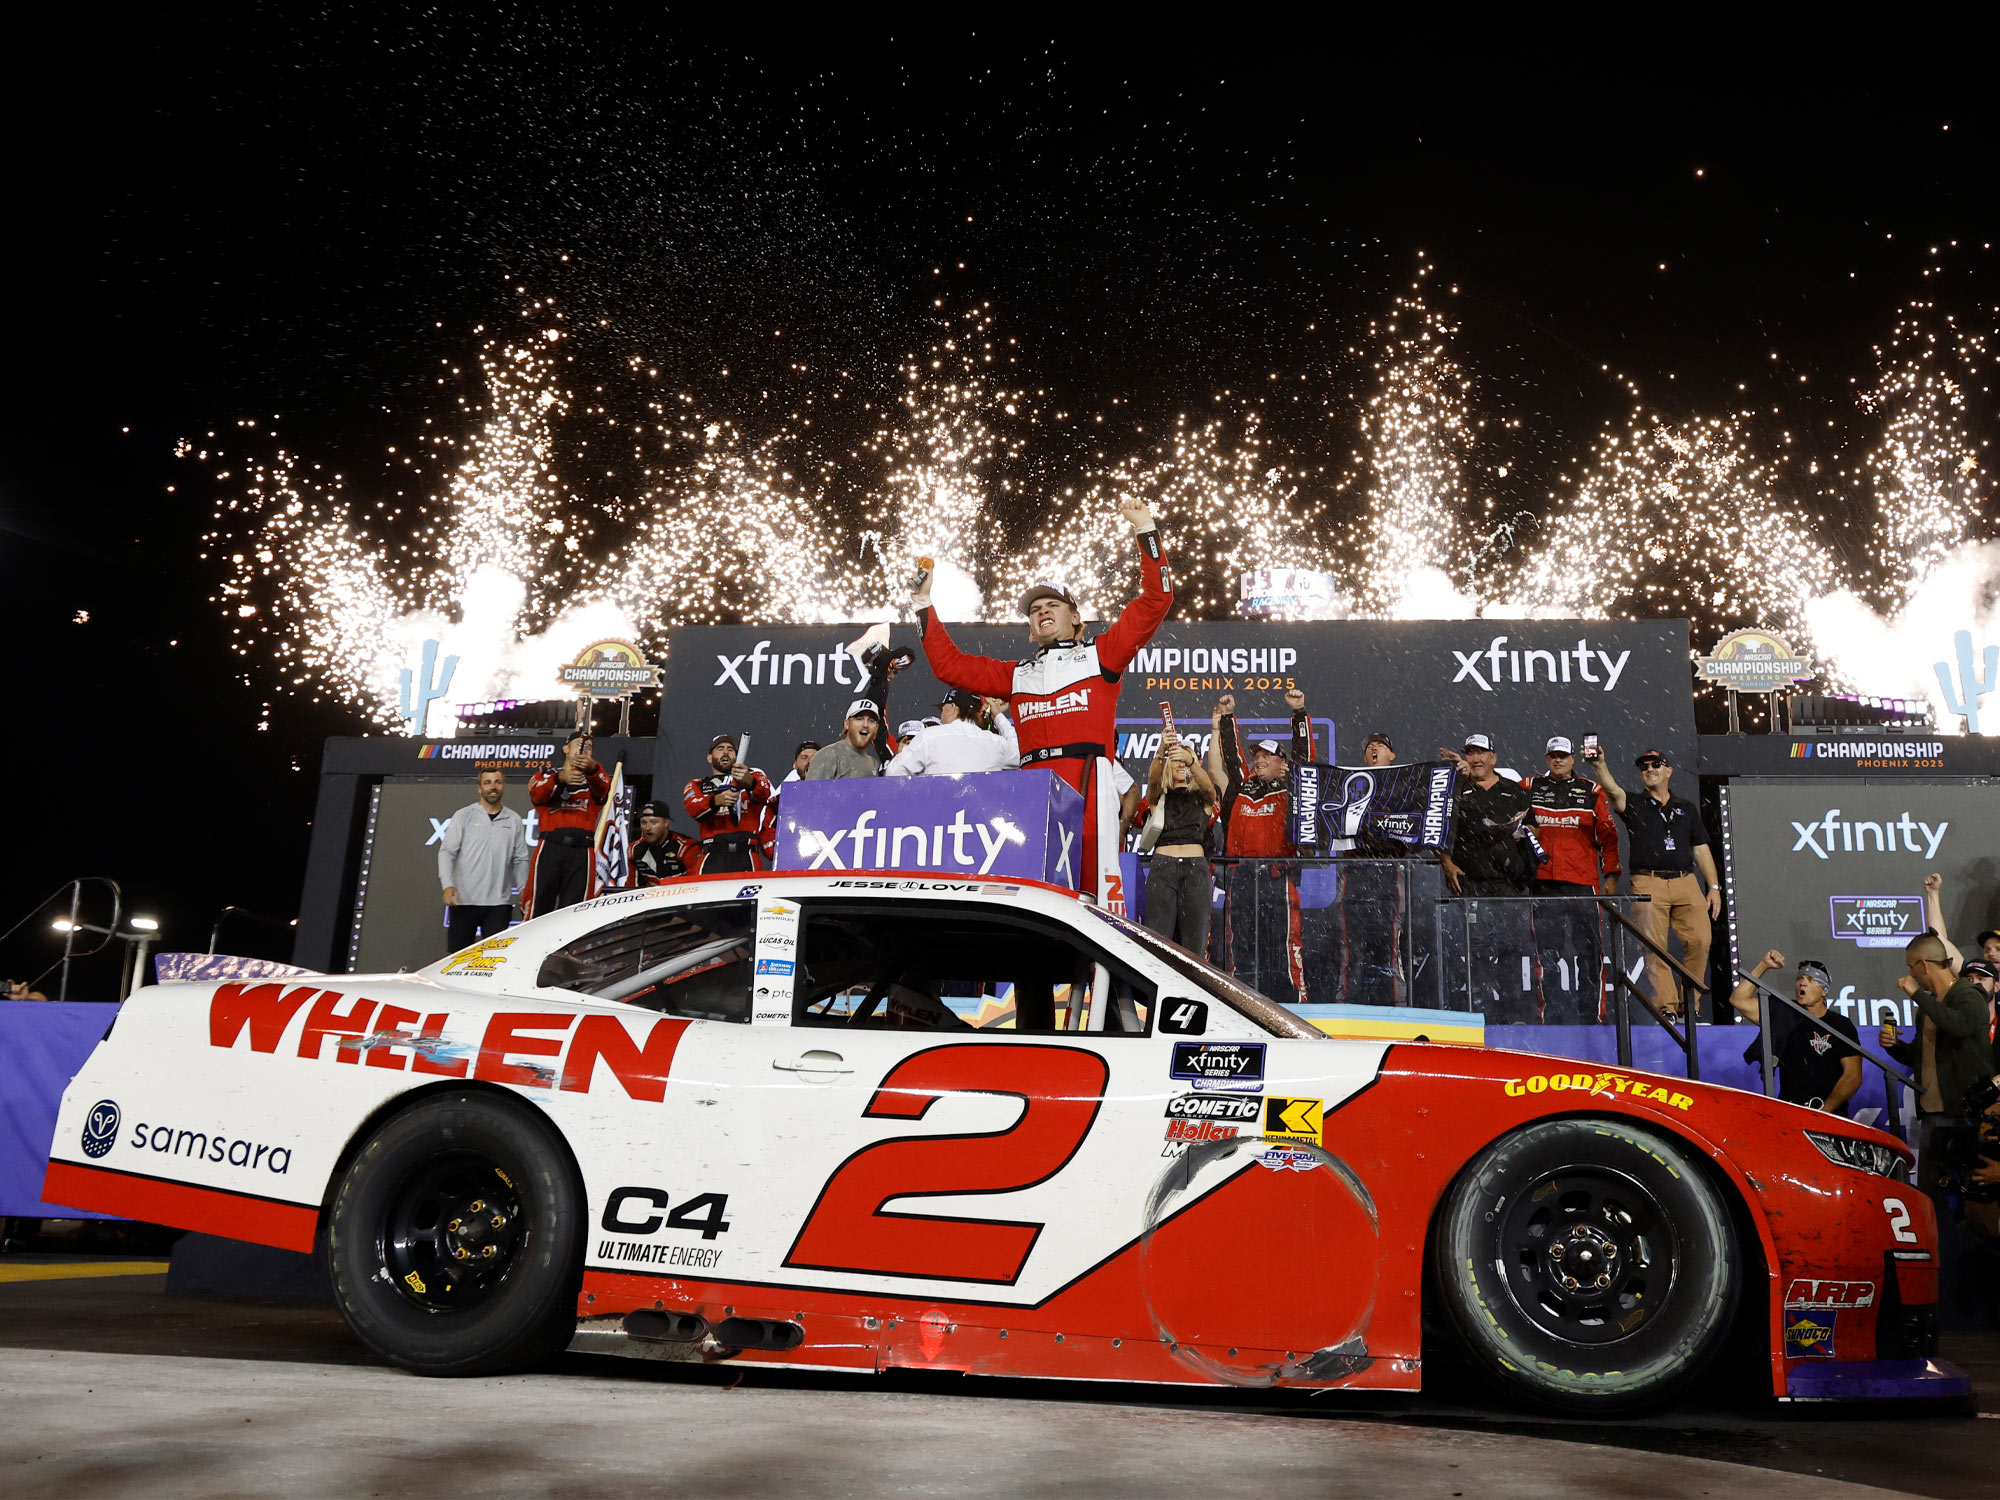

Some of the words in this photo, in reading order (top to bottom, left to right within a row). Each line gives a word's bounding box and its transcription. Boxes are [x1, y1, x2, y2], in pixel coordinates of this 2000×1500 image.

[714, 640, 871, 693] xfinity
[1128, 648, 1296, 673] MPIONSHIP
[1452, 635, 1631, 691] xfinity
[1706, 662, 1802, 674] CHAMPIONSHIP
[564, 668, 650, 682] CHAMPIONSHIP
[1146, 677, 1235, 690] PHOENIX
[1244, 677, 1296, 690] 2025
[1017, 688, 1089, 718] WHELEN
[441, 744, 555, 759] CHAMPIONSHIP
[1816, 742, 1944, 758] CHAMPIONSHIP
[1857, 760, 1909, 768] PHOENIX
[1914, 760, 1945, 768] 2025
[1300, 767, 1317, 843] CHAMPION
[1424, 769, 1450, 845] CHAMPION
[1377, 818, 1414, 832] xfinity
[1791, 809, 1949, 859] xfinity
[808, 810, 1009, 874] xfinity
[592, 886, 699, 908] HomeSmiles
[827, 881, 899, 889] JESSE
[918, 883, 979, 892] LOVE
[1865, 900, 1897, 908] NASCAR
[1846, 909, 1909, 930] xfinity
[759, 937, 783, 945] LUCAS
[783, 938, 795, 946] OIL
[1866, 927, 1892, 935] SERIES
[772, 989, 793, 999] ptc
[1170, 1004, 1198, 1030] 4
[209, 982, 693, 1104] WHELEN
[1209, 1045, 1240, 1053] NASCAR
[1187, 1052, 1250, 1073] xfinity
[1204, 1069, 1230, 1077] SERIES
[1169, 1097, 1260, 1118] COMETIC
[130, 1119, 292, 1175] samsara
[1264, 1151, 1289, 1160] FIVE
[780, 1042, 1110, 1287] 2
[601, 1186, 730, 1240] C4
[1882, 1197, 1918, 1244] 2
[597, 1240, 667, 1265] ULTIMATE
[669, 1246, 723, 1269] ENERGY
[1789, 1279, 1874, 1304] ARP
[1786, 1326, 1831, 1341] SUNOCO
